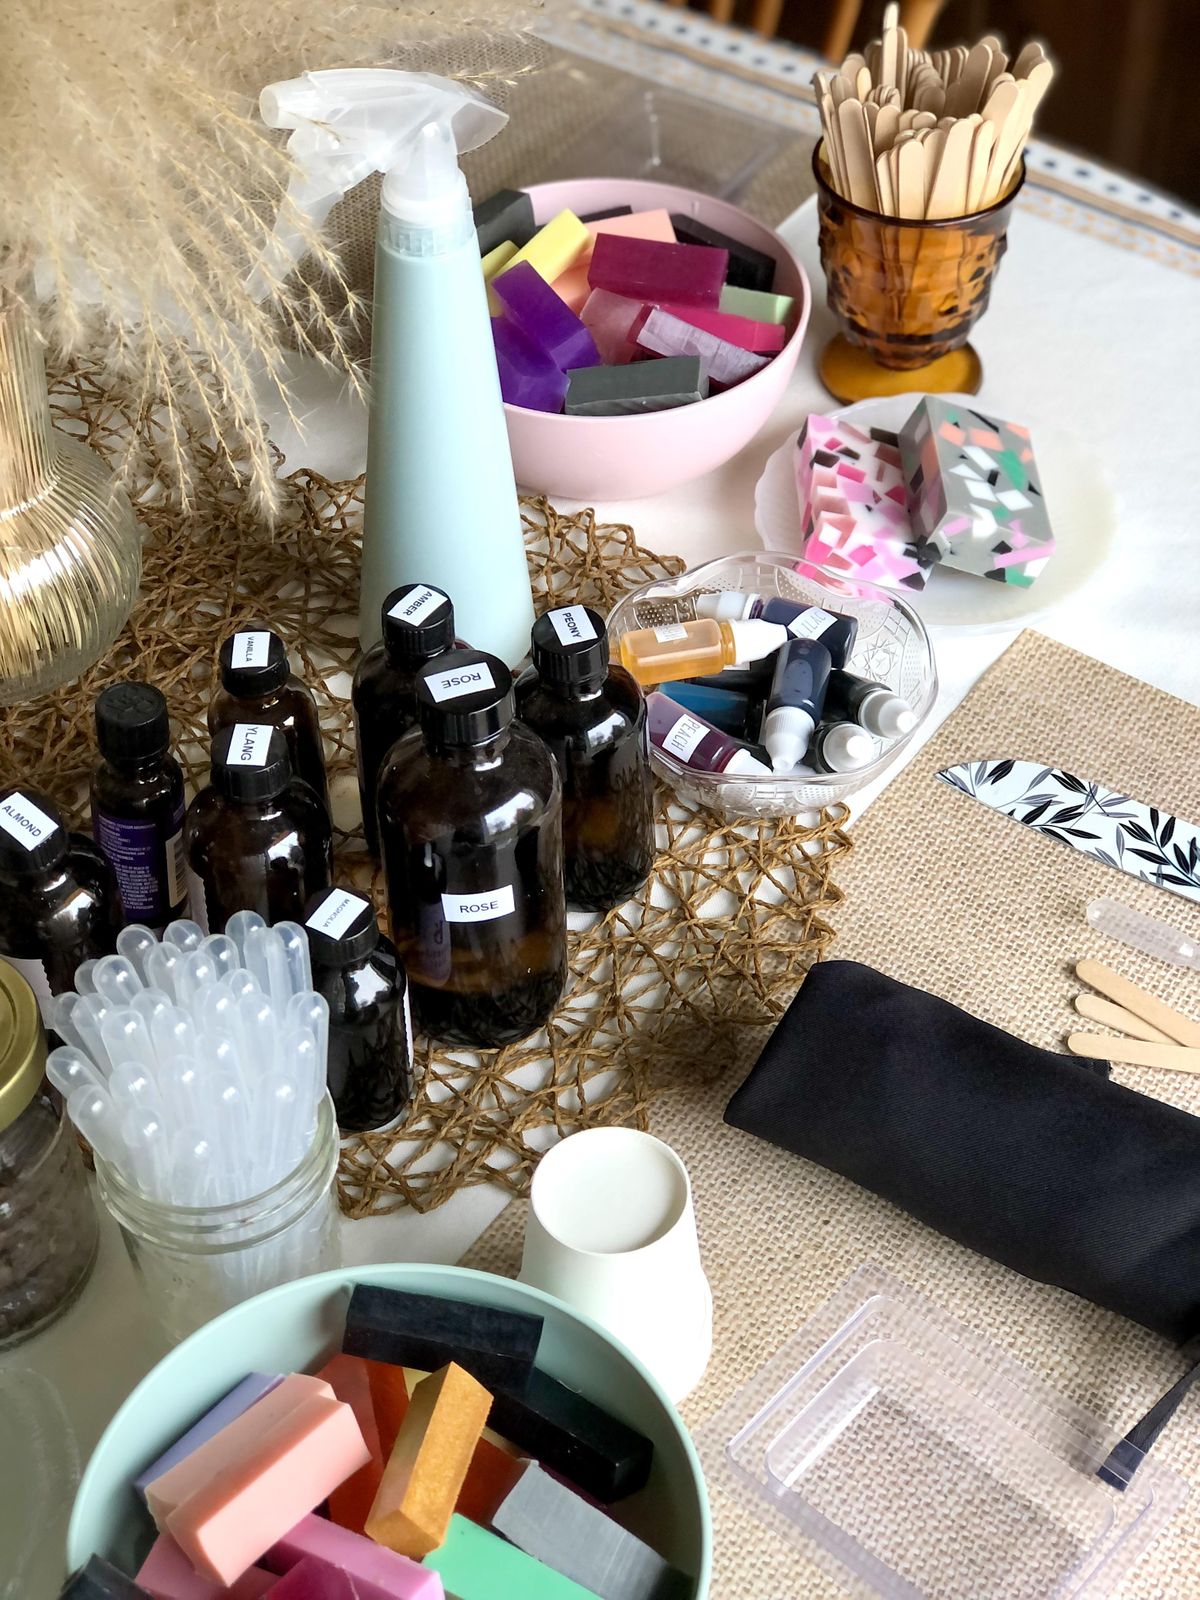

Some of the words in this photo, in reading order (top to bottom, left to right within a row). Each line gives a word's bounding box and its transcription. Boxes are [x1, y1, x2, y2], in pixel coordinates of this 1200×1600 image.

[403, 591, 432, 616] AMBER
[562, 612, 582, 638] PEONY
[246, 636, 254, 662] VANILLA
[441, 672, 482, 689] ROSE
[240, 727, 259, 761] YLANG
[671, 718, 701, 752] PEACH
[2, 805, 42, 837] ALMOND
[322, 898, 350, 928] MAGNOLIA
[459, 900, 499, 914] ROSE
